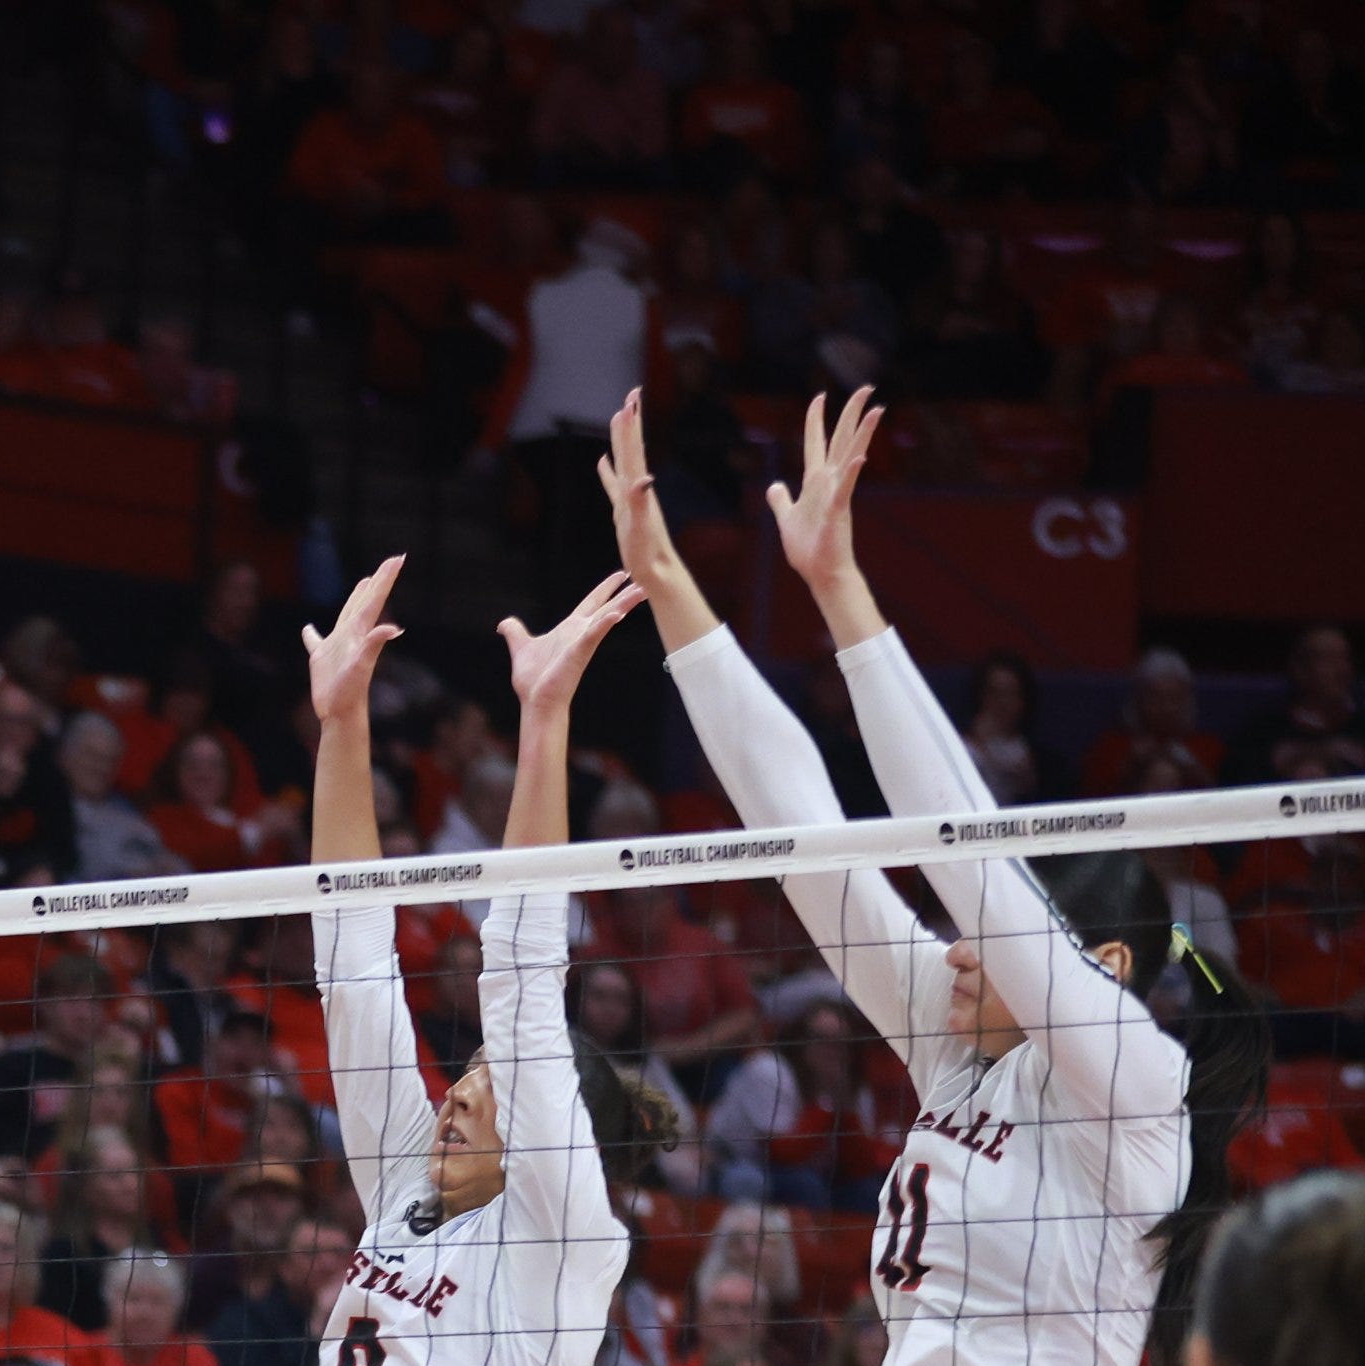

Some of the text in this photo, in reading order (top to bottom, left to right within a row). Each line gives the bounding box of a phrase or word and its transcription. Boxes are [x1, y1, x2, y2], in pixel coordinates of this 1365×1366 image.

[1032, 498, 1126, 559] C3
[958, 811, 1126, 842] VOLLEYBALL CHAMPIONSHIP
[637, 838, 795, 868] VOLLEYBALL CHAMPIONSHIP
[333, 863, 482, 891] VOLLEYBALL CHAMPIONSHIP
[48, 887, 189, 913] VOLLEYBALL CHAMPIONSHIP
[875, 1162, 932, 1292] 11
